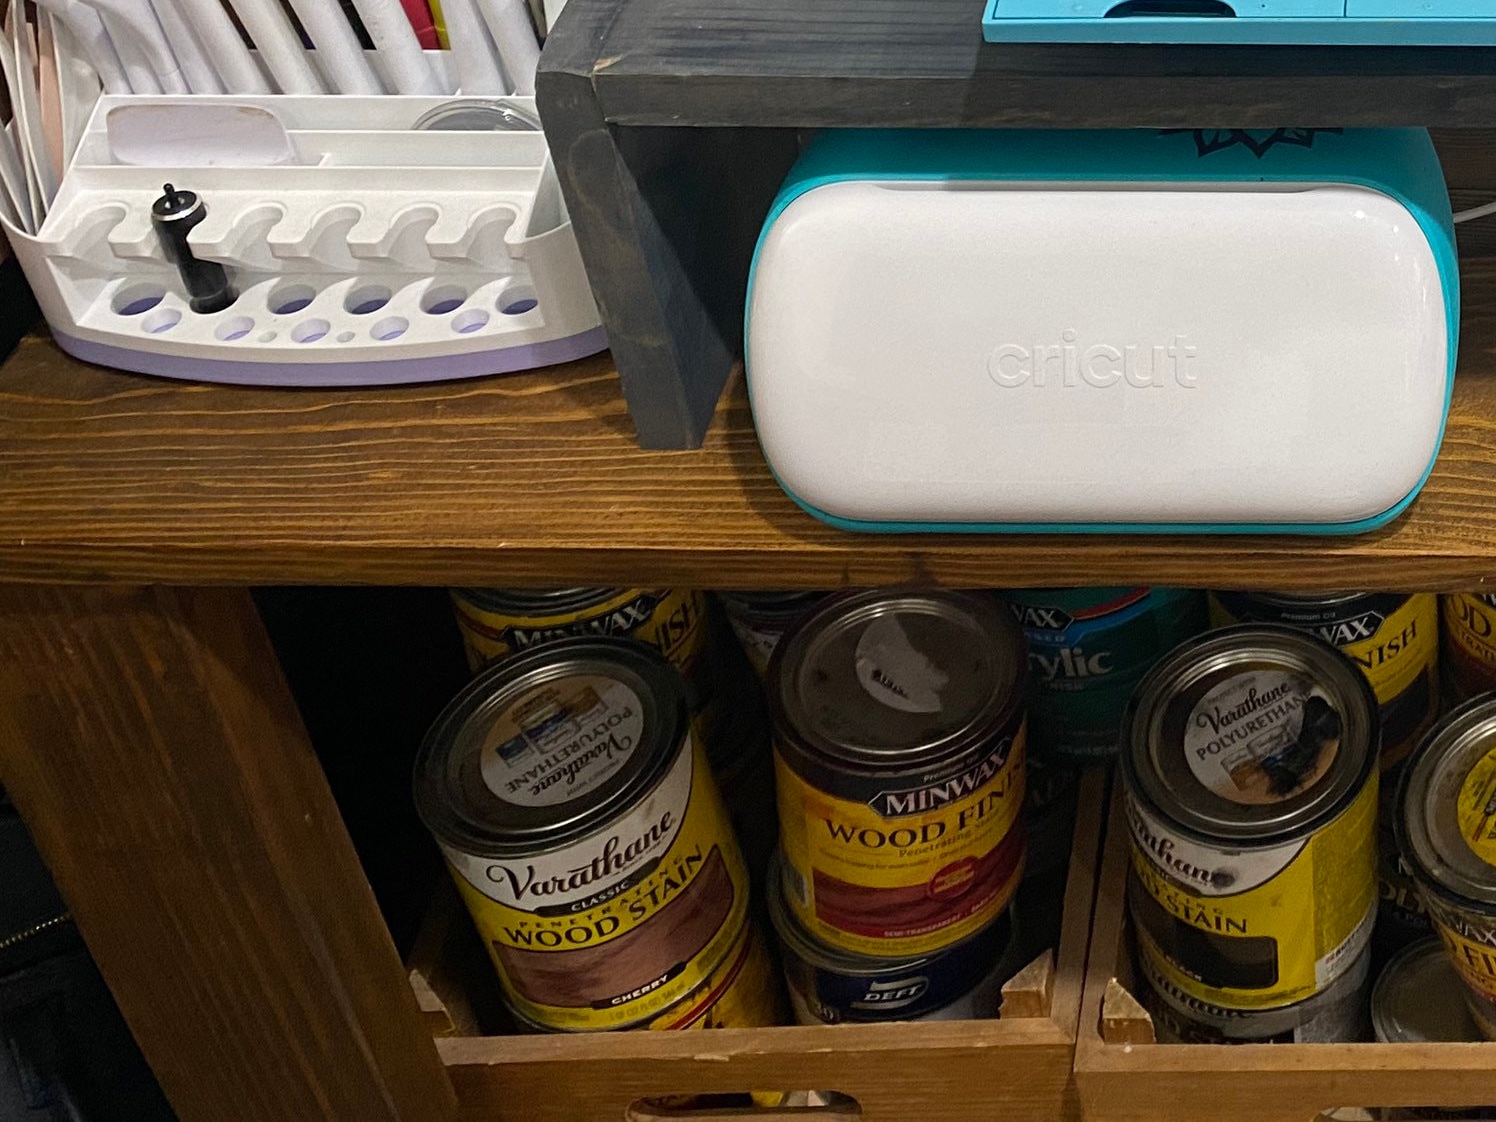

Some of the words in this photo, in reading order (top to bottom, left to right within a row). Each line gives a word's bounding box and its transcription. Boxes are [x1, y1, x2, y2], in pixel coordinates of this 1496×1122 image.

[987, 328, 1198, 391] cricut
[1196, 681, 1290, 735] Varathane
[505, 706, 633, 795] POLYURETHANE
[532, 735, 633, 797] Varathane
[886, 750, 1006, 816] MINWAX
[486, 811, 673, 901] Varathane
[822, 817, 946, 849] WOOD
[504, 915, 620, 947] WOOD
[628, 844, 703, 922] STAIN
[519, 856, 684, 929] PENETRATING
[570, 881, 630, 912] CLASSIC
[611, 974, 668, 1005] CHERRY
[863, 984, 920, 1003] DEFT
